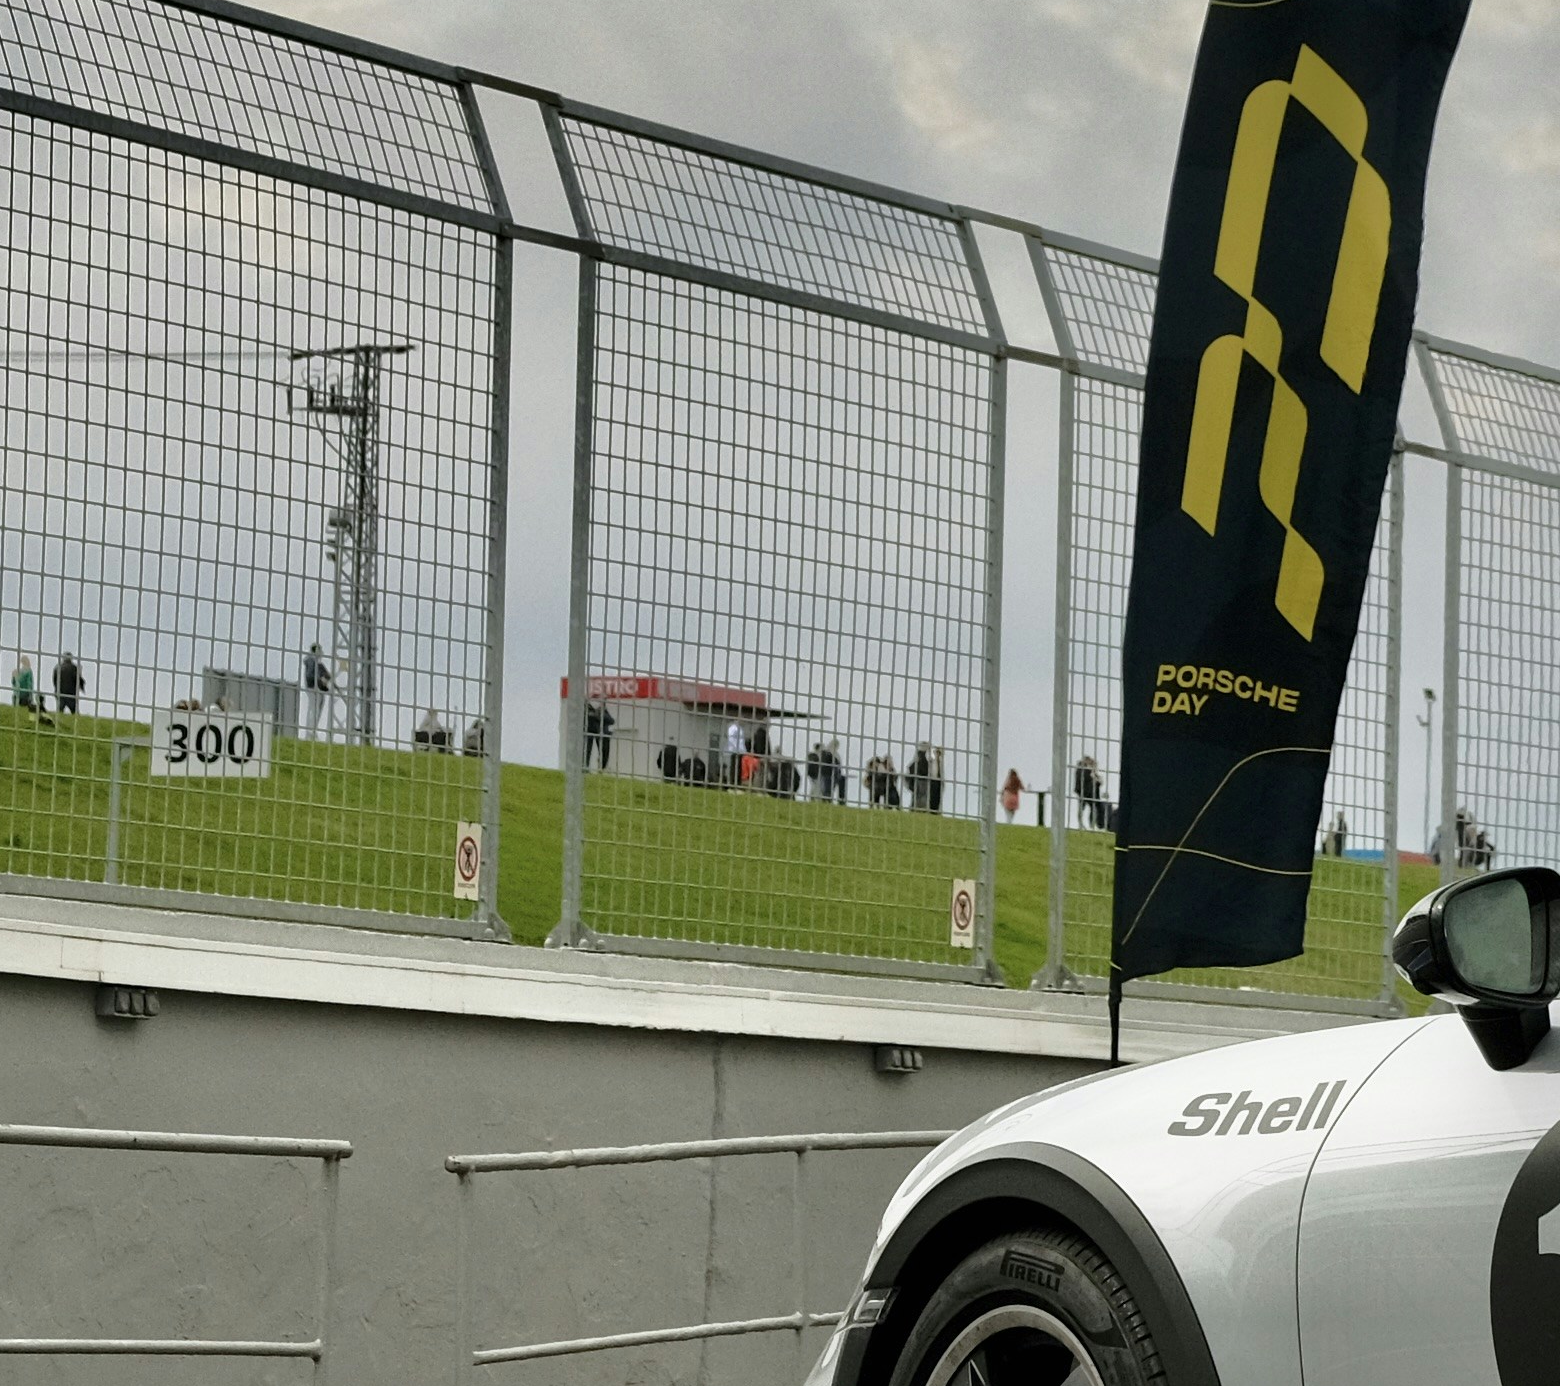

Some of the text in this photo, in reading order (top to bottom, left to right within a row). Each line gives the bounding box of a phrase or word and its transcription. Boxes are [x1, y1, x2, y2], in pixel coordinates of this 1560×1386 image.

[1151, 690, 1210, 718] DAY
[1156, 663, 1300, 712] PORSCHE
[165, 723, 254, 764] 300
[1167, 1079, 1348, 1137] Shell
[998, 1249, 1066, 1292] PIRELLI
